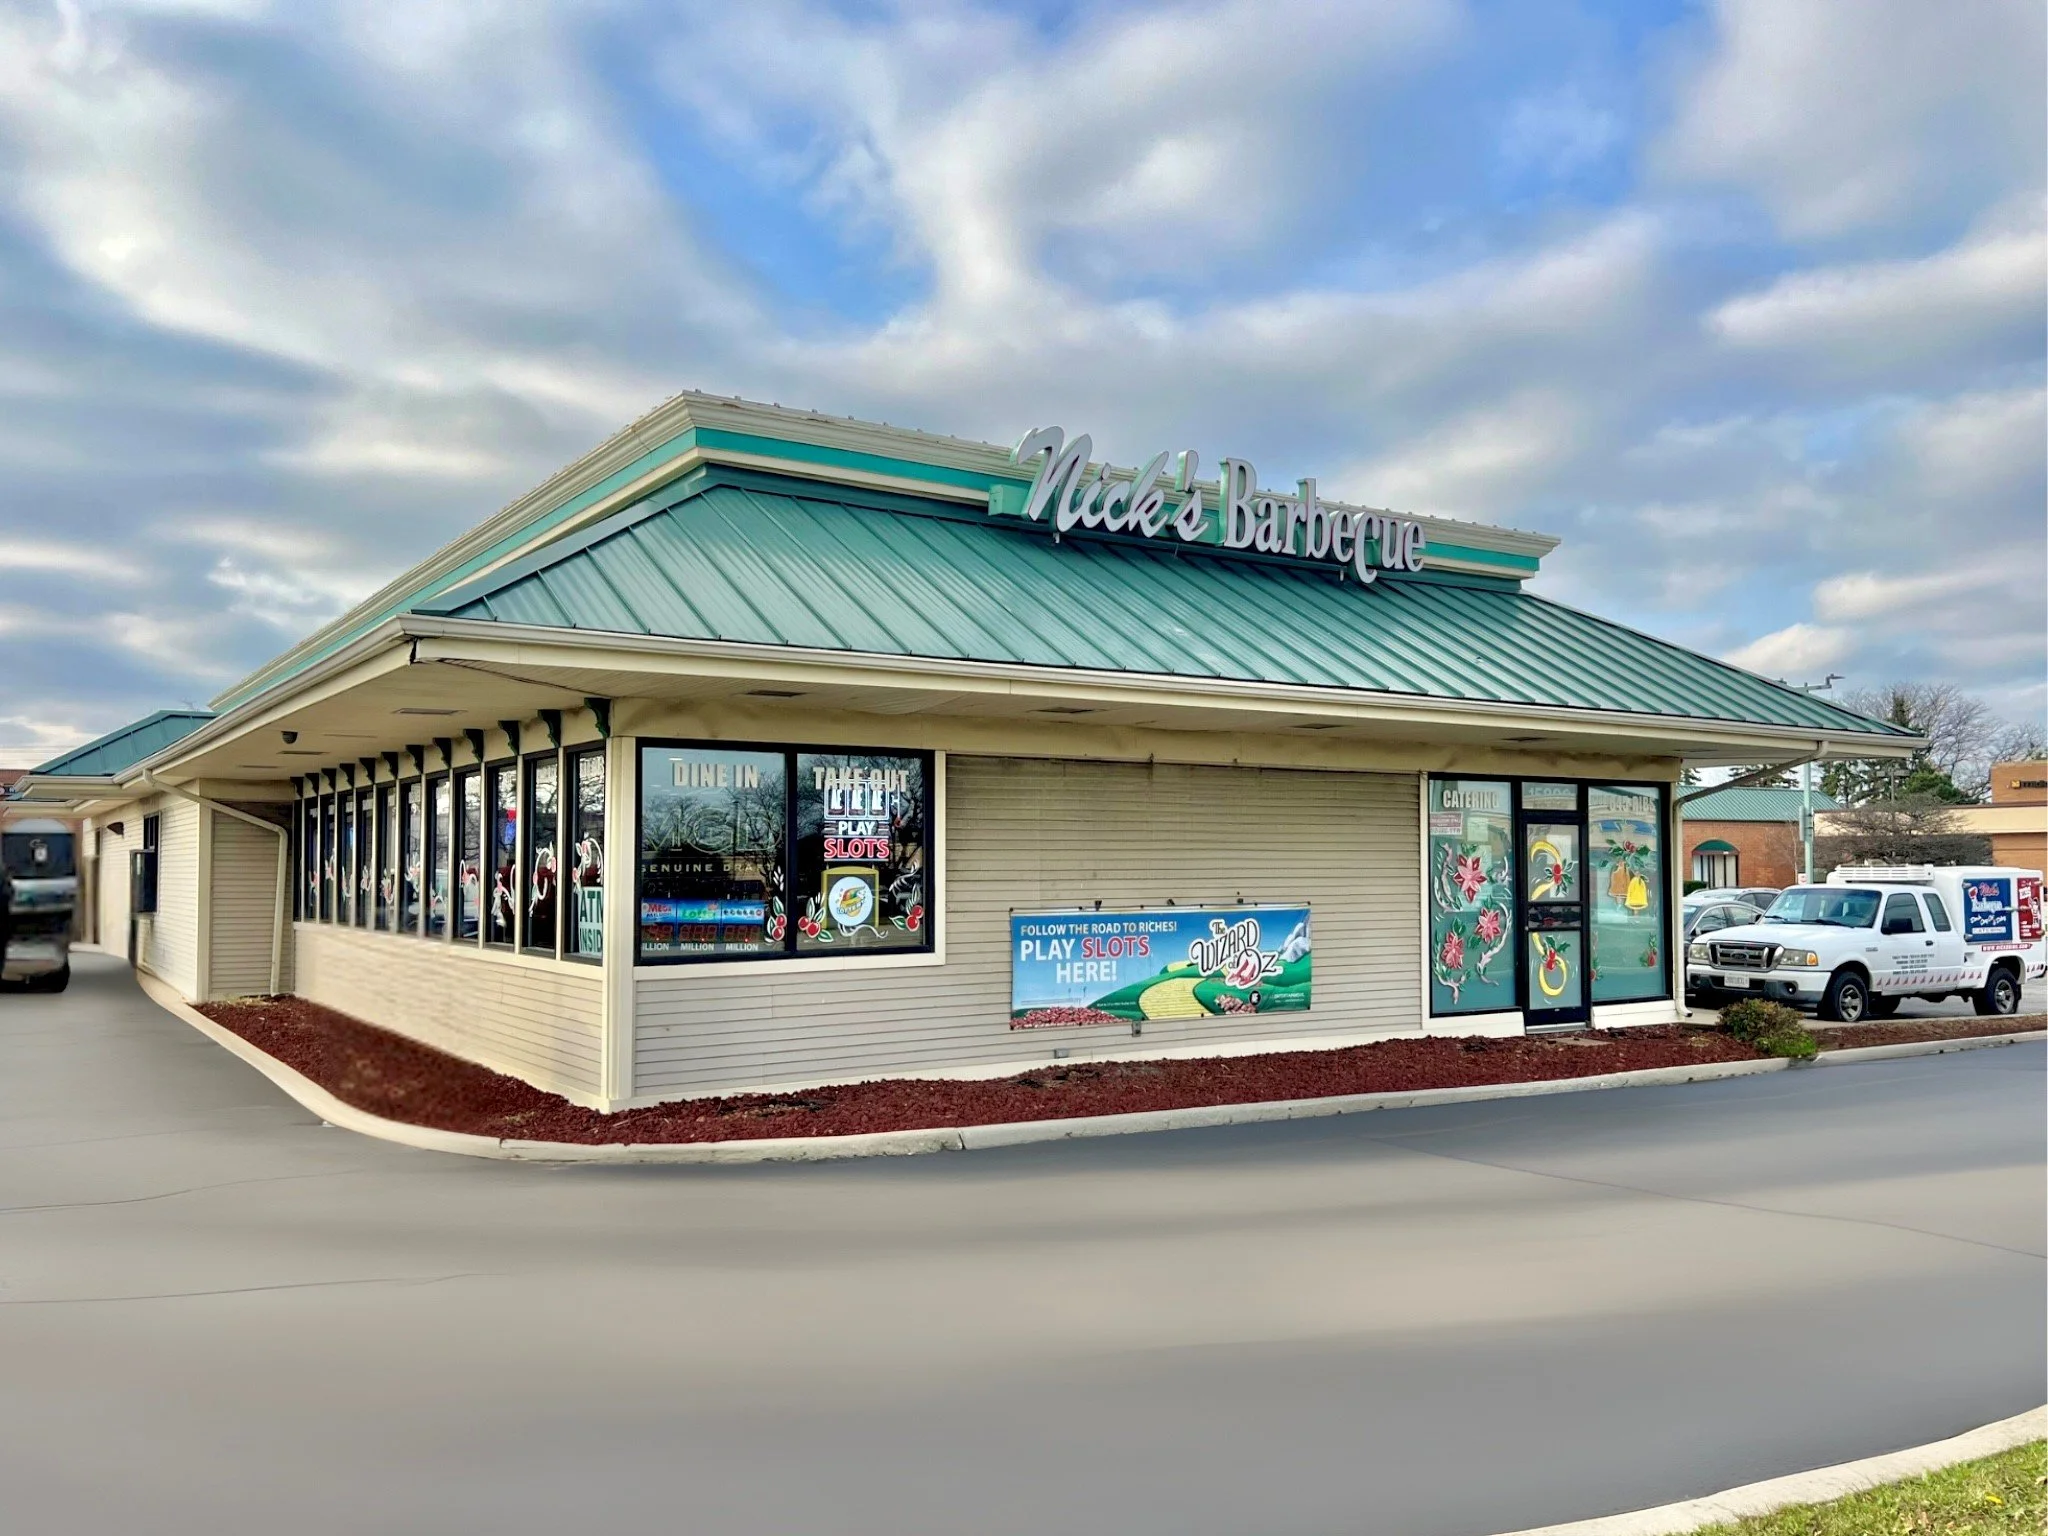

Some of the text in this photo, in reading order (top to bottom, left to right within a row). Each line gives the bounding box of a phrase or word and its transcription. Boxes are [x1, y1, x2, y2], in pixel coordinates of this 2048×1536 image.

[1009, 425, 1426, 584] Nick's Barbecue
[673, 763, 758, 788] DINE IN
[813, 766, 909, 792] TAKE OUT
[1442, 789, 1500, 809] CATERING
[838, 821, 875, 836] PLAY
[823, 838, 890, 859] SLOTS
[580, 928, 603, 952] INSID
[1020, 920, 1177, 936] FOLLOW THE ROAD TO RICHES!
[642, 943, 759, 951] ILLION MILLION MILLION
[1020, 936, 1150, 961] PLAY SLOTS
[1191, 920, 1259, 973] WIZARD
[1056, 960, 1117, 984] HERE!
